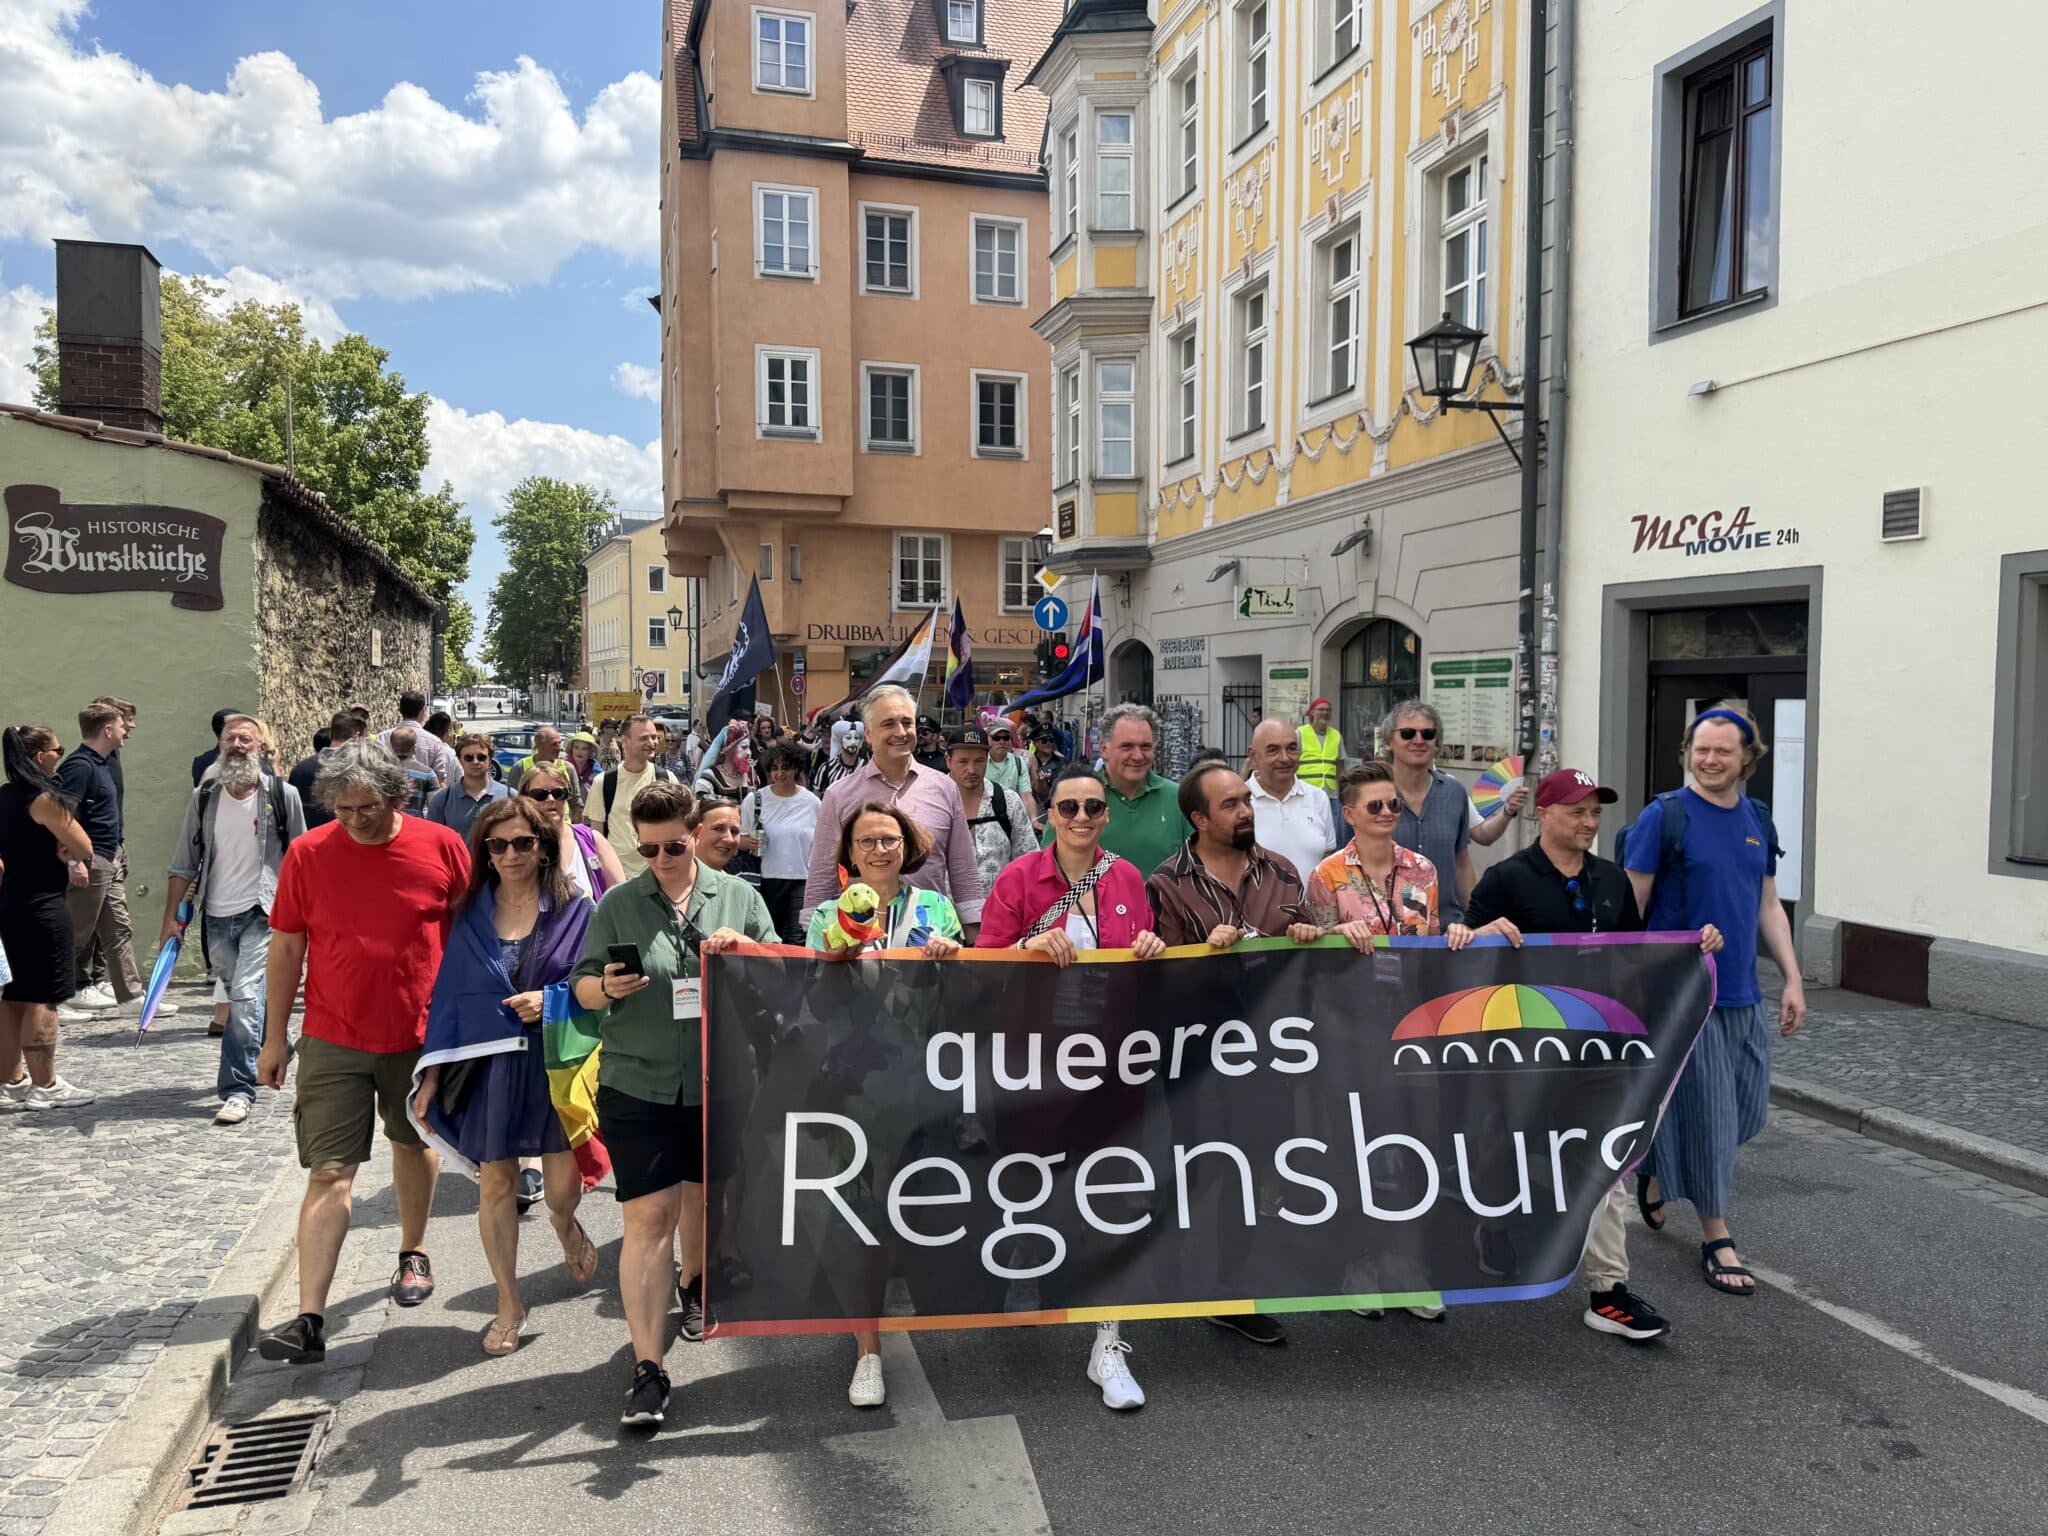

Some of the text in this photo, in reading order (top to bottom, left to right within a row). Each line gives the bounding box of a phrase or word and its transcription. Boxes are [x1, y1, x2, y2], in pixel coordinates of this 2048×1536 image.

[87, 520, 200, 540] HISTORISCHE
[1631, 506, 1756, 554] MEGA
[1685, 528, 1799, 556] MOVIE 24h
[15, 511, 209, 582] Wurstküche
[807, 624, 885, 642] DRUBBA
[645, 675, 656, 684] 30
[602, 704, 632, 712] DHL
[926, 1016, 1319, 1114] queeres
